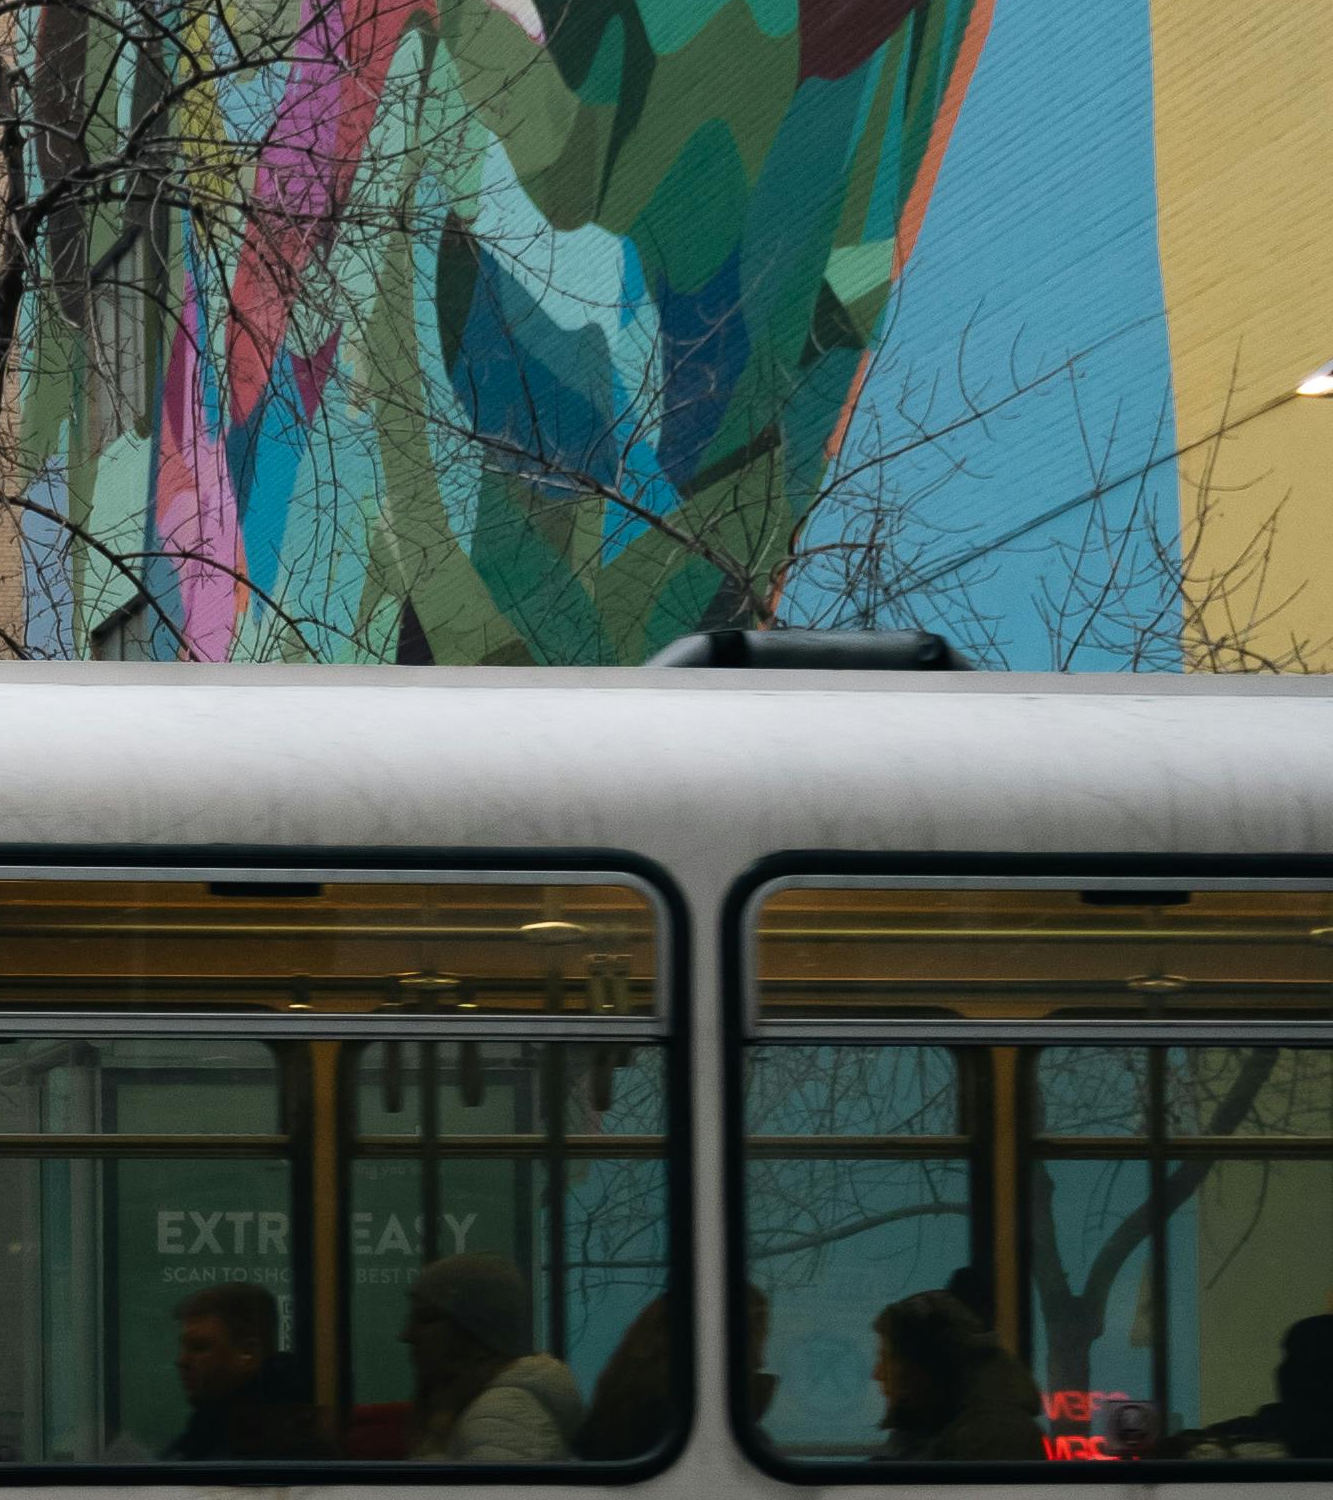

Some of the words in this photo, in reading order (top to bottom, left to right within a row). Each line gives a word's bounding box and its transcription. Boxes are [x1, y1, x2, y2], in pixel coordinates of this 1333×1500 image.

[155, 1210, 291, 1255] EXTR
[162, 1267, 218, 1284] SCAN
[221, 1267, 249, 1284] TO
[252, 1267, 293, 1284] SHO
[355, 1268, 401, 1285] BEST
